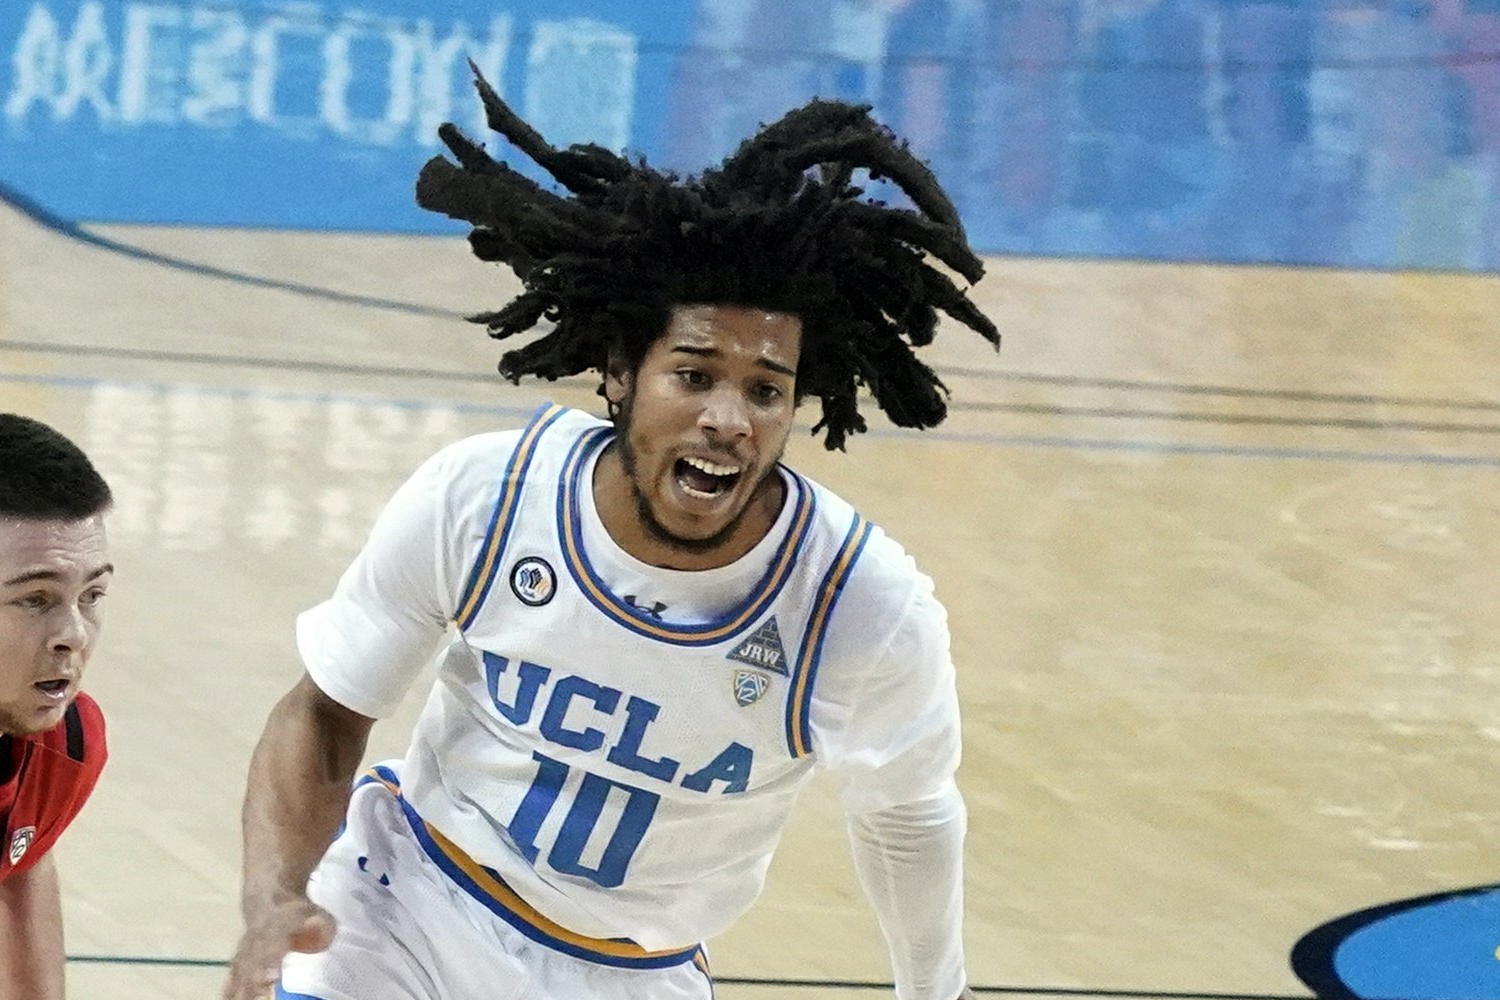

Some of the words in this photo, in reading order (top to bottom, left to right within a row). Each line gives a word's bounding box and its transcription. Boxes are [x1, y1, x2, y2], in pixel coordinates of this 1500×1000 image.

[483, 650, 754, 794] UCLA
[739, 643, 781, 665] JRW
[507, 750, 661, 888] 10
